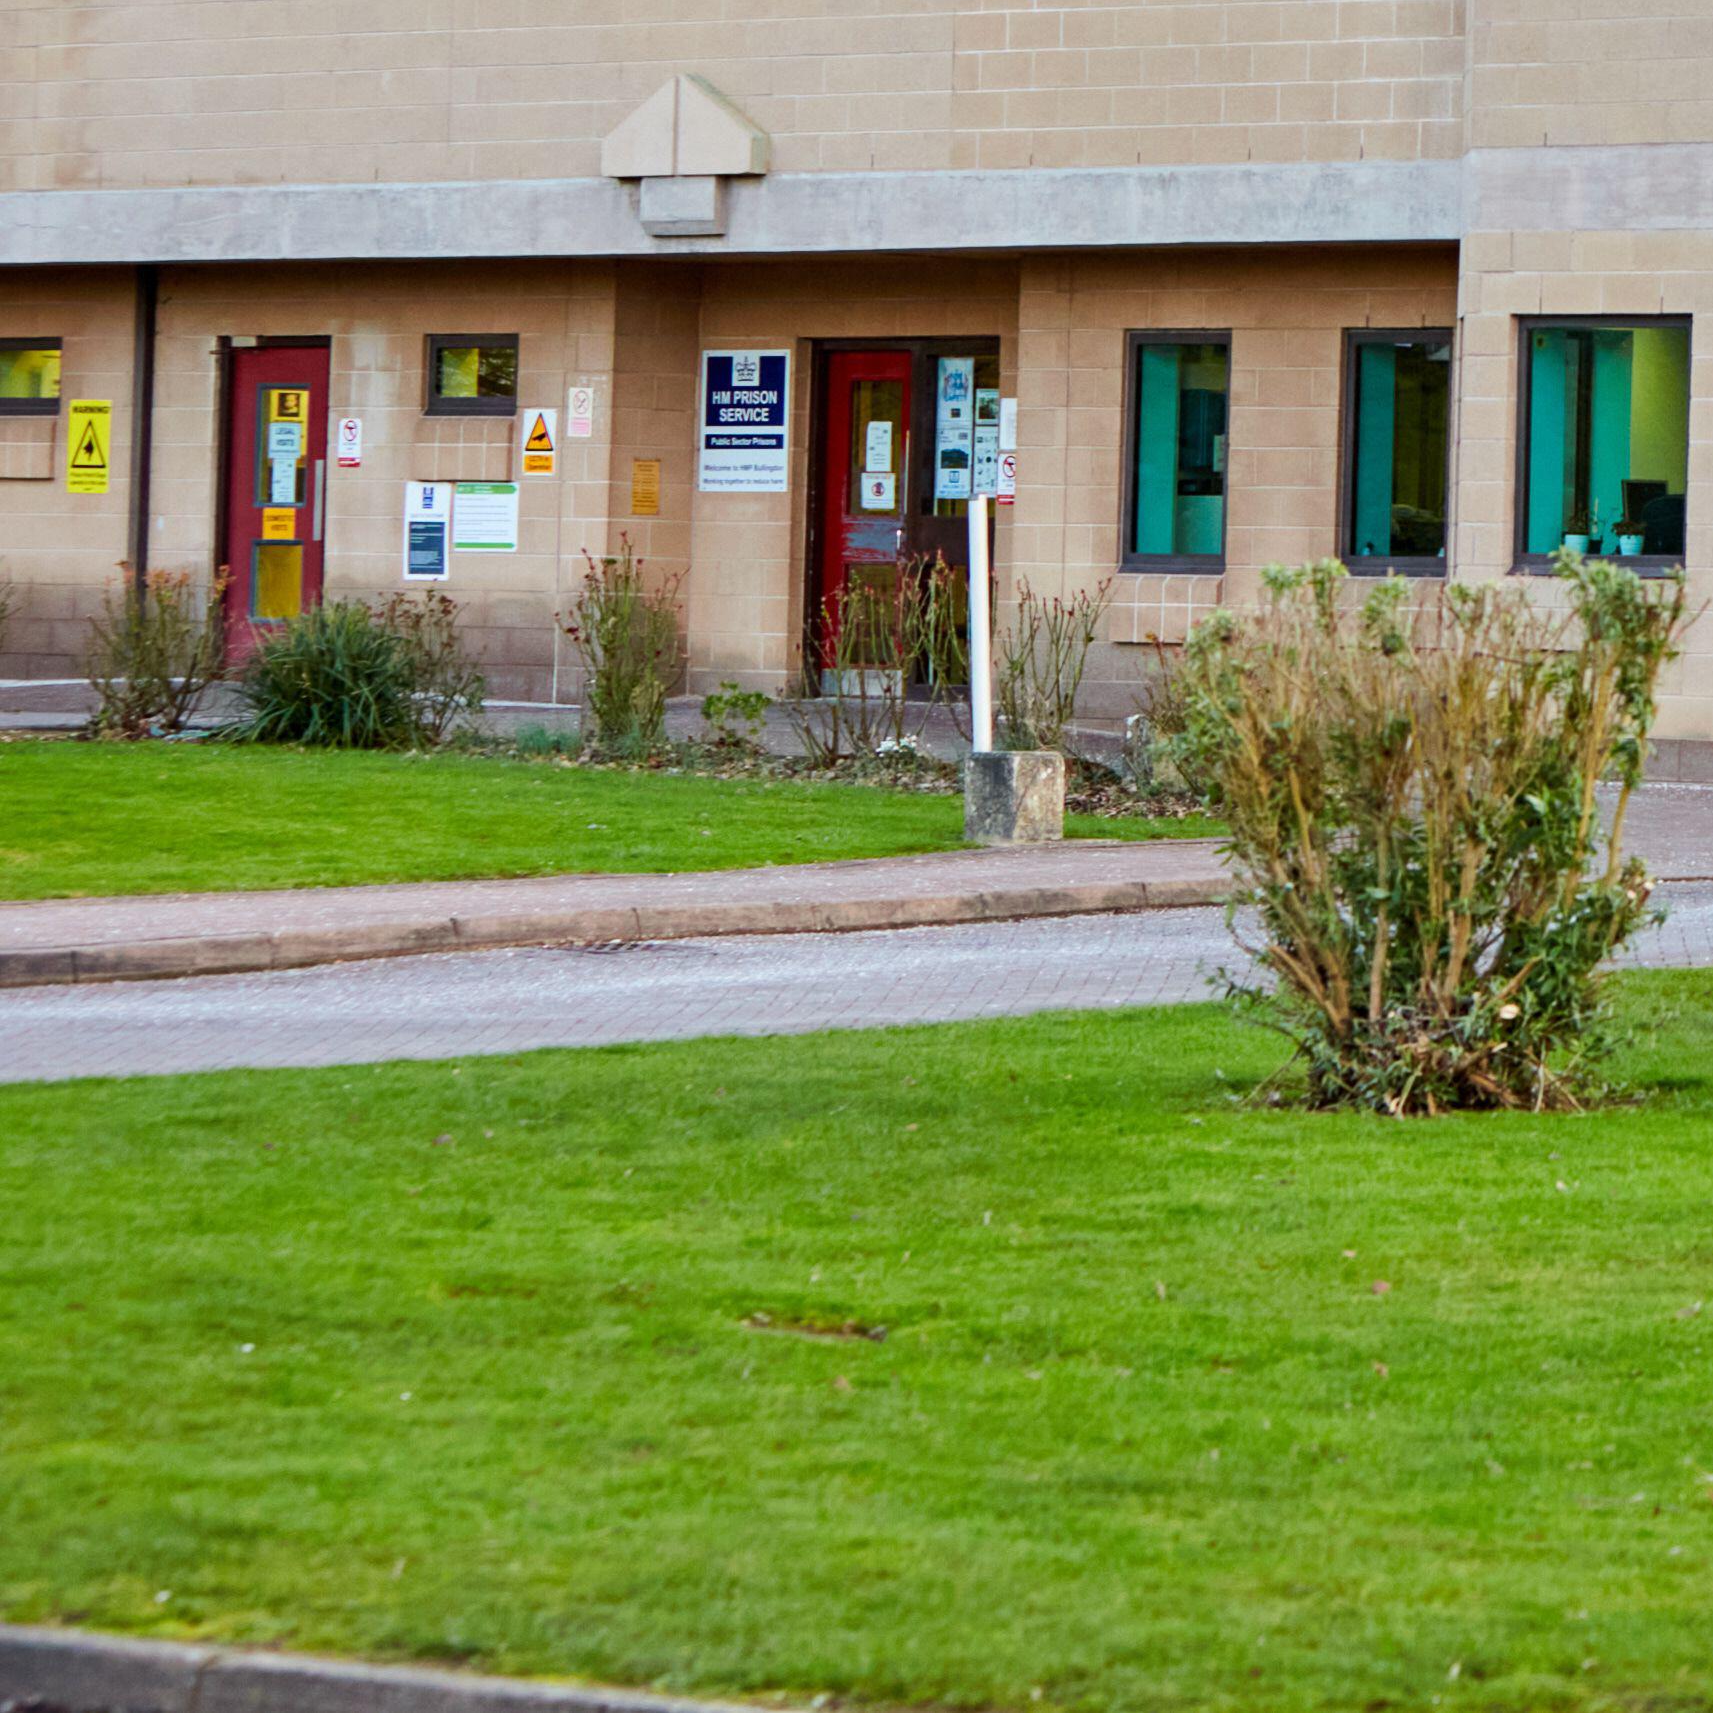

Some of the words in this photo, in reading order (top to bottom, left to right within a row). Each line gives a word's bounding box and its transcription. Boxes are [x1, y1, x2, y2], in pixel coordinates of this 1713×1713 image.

[712, 390, 731, 404] HM
[733, 390, 777, 404] PRISON
[719, 407, 770, 422] SERVICE
